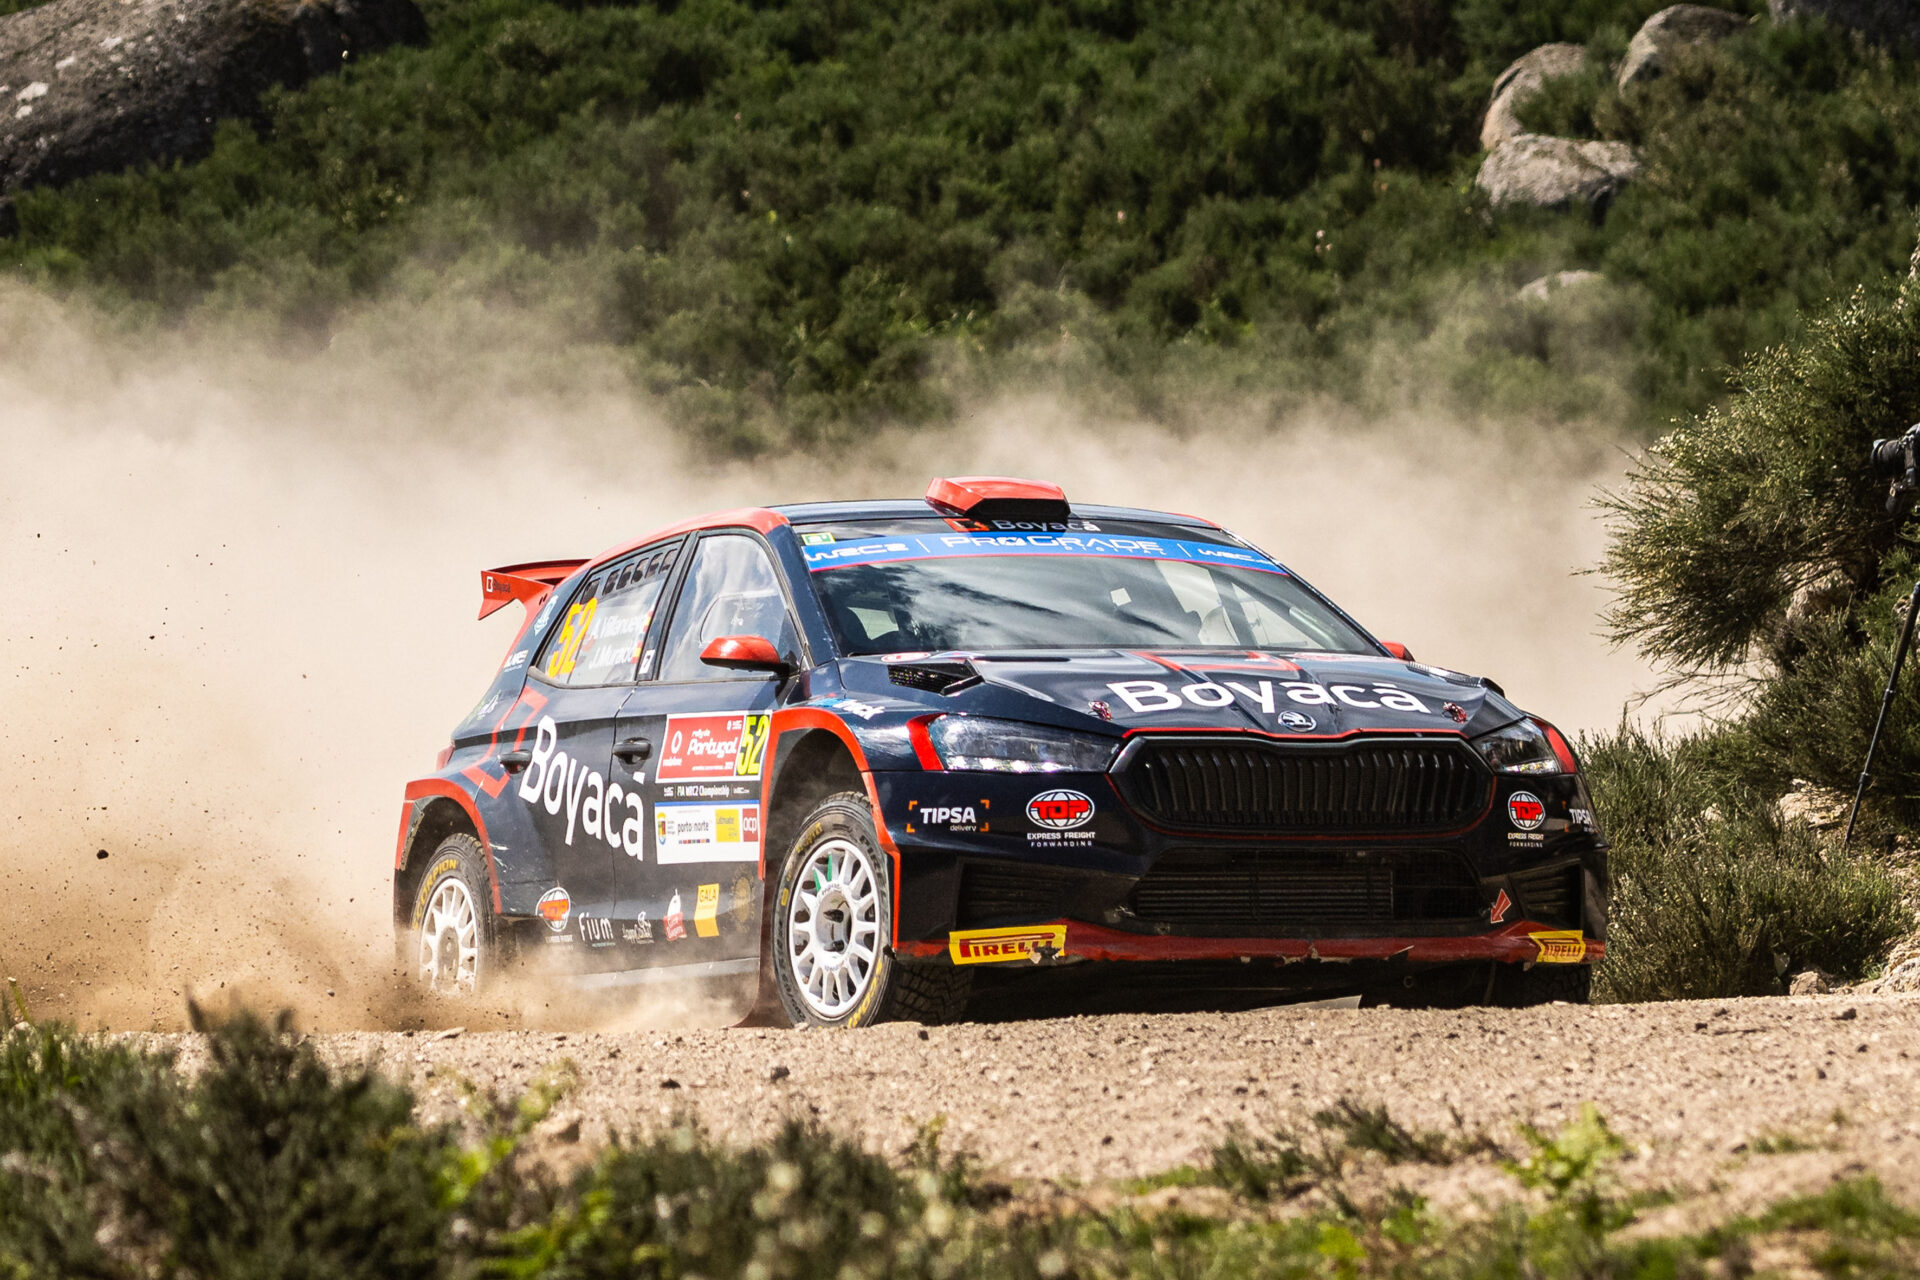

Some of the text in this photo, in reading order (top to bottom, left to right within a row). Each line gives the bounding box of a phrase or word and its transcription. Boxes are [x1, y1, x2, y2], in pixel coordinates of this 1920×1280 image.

[548, 598, 598, 678] 52
[687, 736, 738, 758] Portugal
[737, 715, 770, 775] 52
[920, 807, 977, 824] TIPSA
[1030, 800, 1092, 820] TOP
[1510, 801, 1543, 820] TOP
[1568, 808, 1593, 825] TIPSA
[949, 824, 977, 832] delivery
[1027, 831, 1096, 840] EXPRESS FREIGHT
[699, 888, 717, 903] GALA
[1538, 938, 1582, 956] PIRELLI
